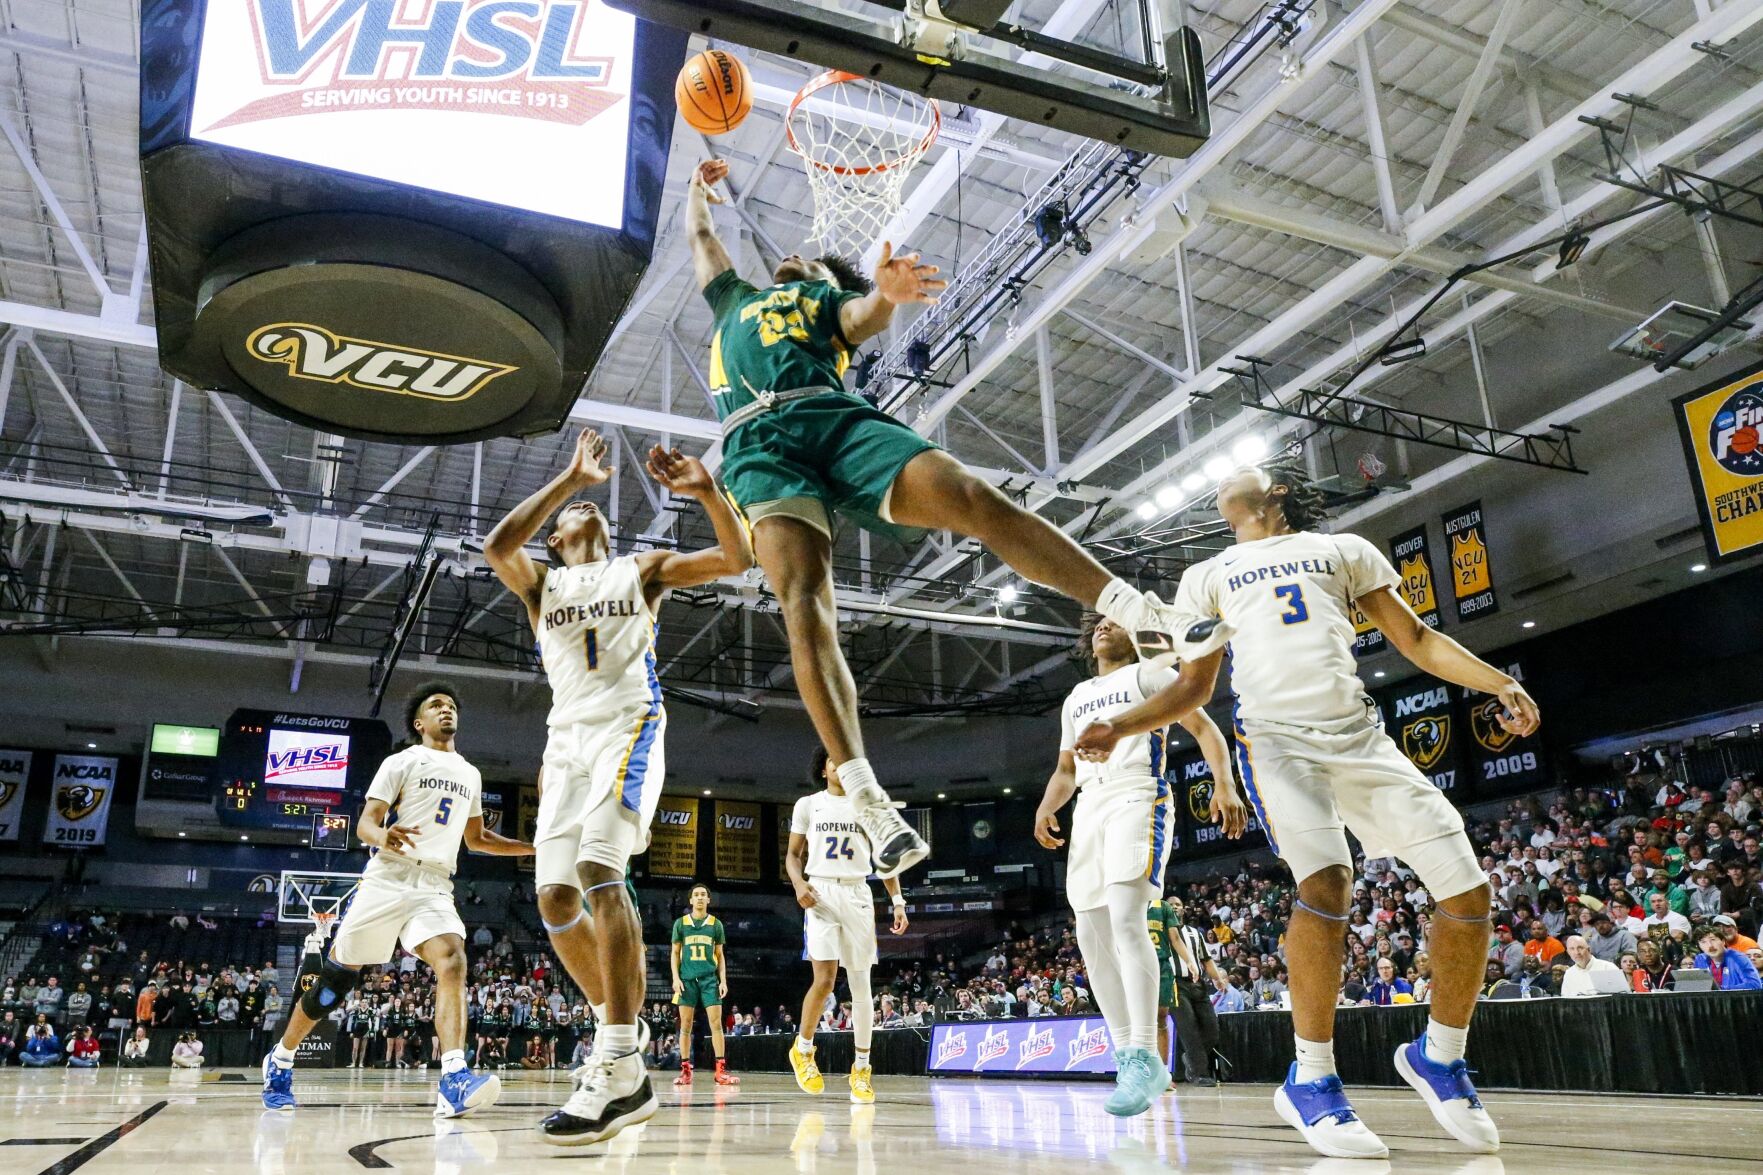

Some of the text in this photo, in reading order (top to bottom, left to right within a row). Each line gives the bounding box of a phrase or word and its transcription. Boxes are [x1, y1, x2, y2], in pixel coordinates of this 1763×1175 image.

[256, 0, 603, 79] VHSL
[301, 86, 569, 109] SERVING YOUTH SINCE 1913
[287, 327, 495, 397] VCU
[1395, 536, 1423, 557] HOOVER
[1454, 550, 1483, 571] VCU
[1228, 558, 1336, 592] HOPEWELL
[1402, 574, 1428, 591] VCU
[1462, 568, 1477, 585] 21
[1274, 582, 1310, 626] 3
[1409, 590, 1425, 608] 20
[1460, 592, 1493, 615] 1999-2003
[545, 600, 640, 630] HOPEWELL
[584, 627, 599, 672] 1
[1396, 686, 1450, 718] NCAA
[273, 714, 350, 729] #LetsGoVCU
[267, 745, 344, 770] VHSL
[1483, 752, 1537, 780] 2009
[56, 764, 112, 780] NCAA
[284, 804, 307, 815] 5:27
[434, 797, 453, 826] 5
[659, 811, 692, 825] VCU
[323, 818, 346, 829] 5:27
[723, 814, 754, 830] VCU
[55, 827, 96, 841] 2019
[825, 836, 855, 860] 24
[690, 945, 707, 961] 11
[940, 1035, 964, 1058] VHSL
[979, 1033, 1007, 1056] VHSL
[1021, 1031, 1051, 1056] VHSL
[1071, 1029, 1105, 1056] VHSL
